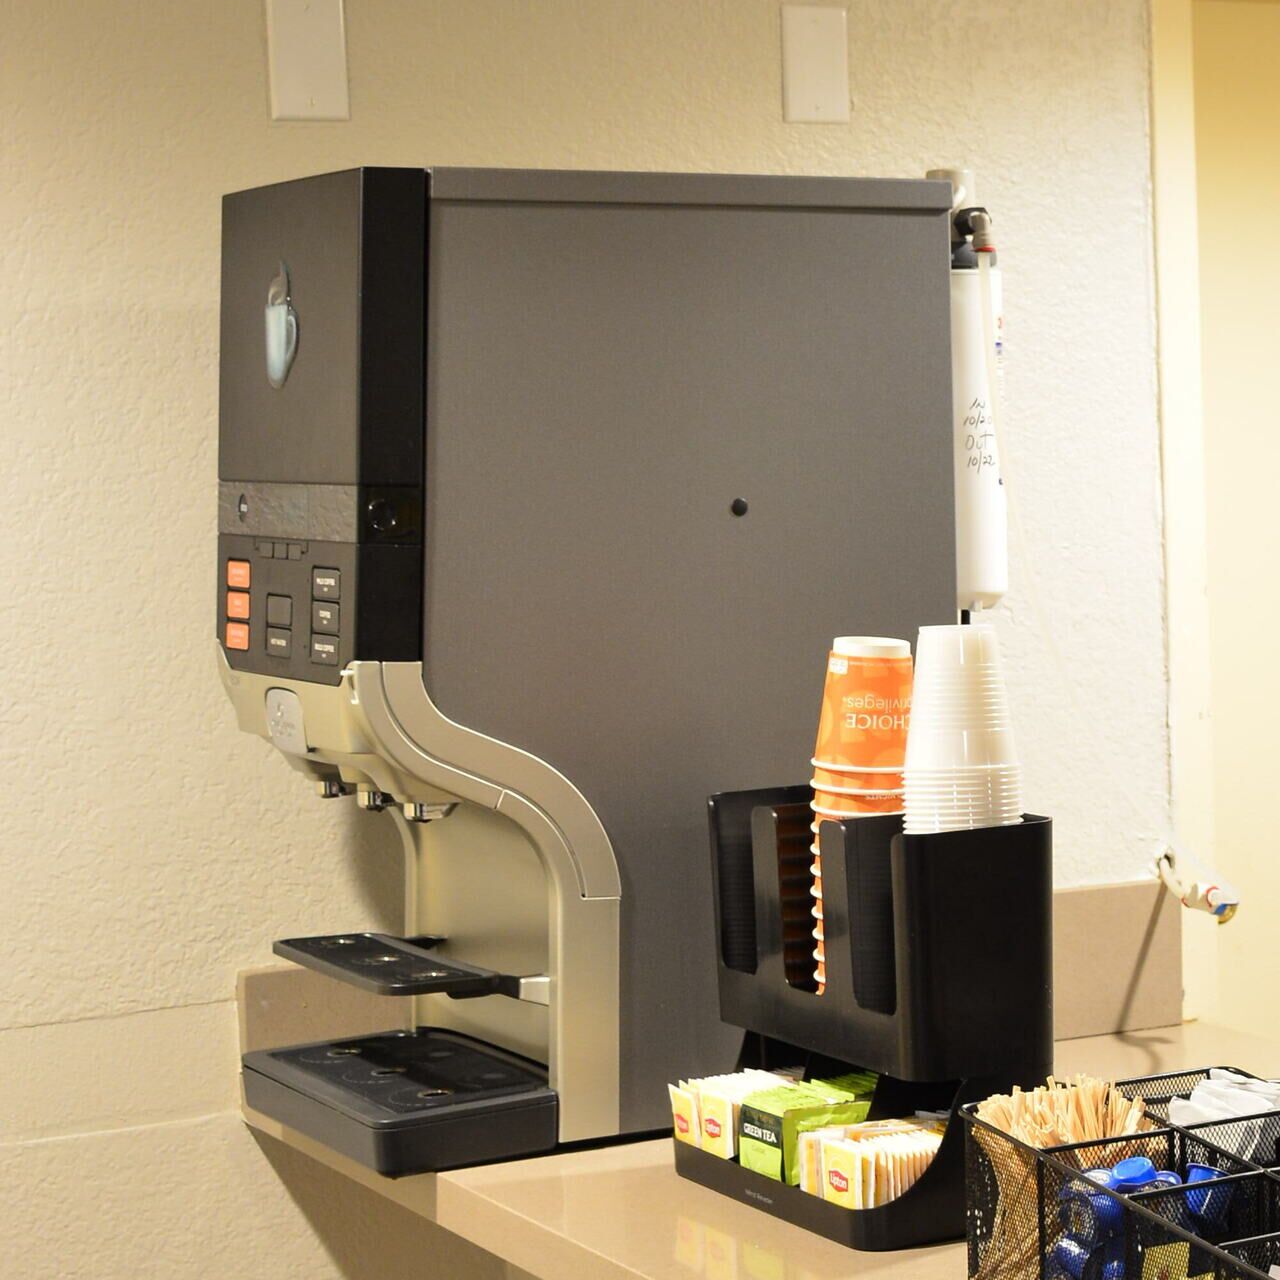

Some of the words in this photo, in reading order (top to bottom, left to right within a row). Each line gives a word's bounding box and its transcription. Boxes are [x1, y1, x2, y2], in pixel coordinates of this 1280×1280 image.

[967, 451, 996, 475] 10/22
[743, 1122, 762, 1139] GREEN
[762, 1129, 777, 1143] TEA
